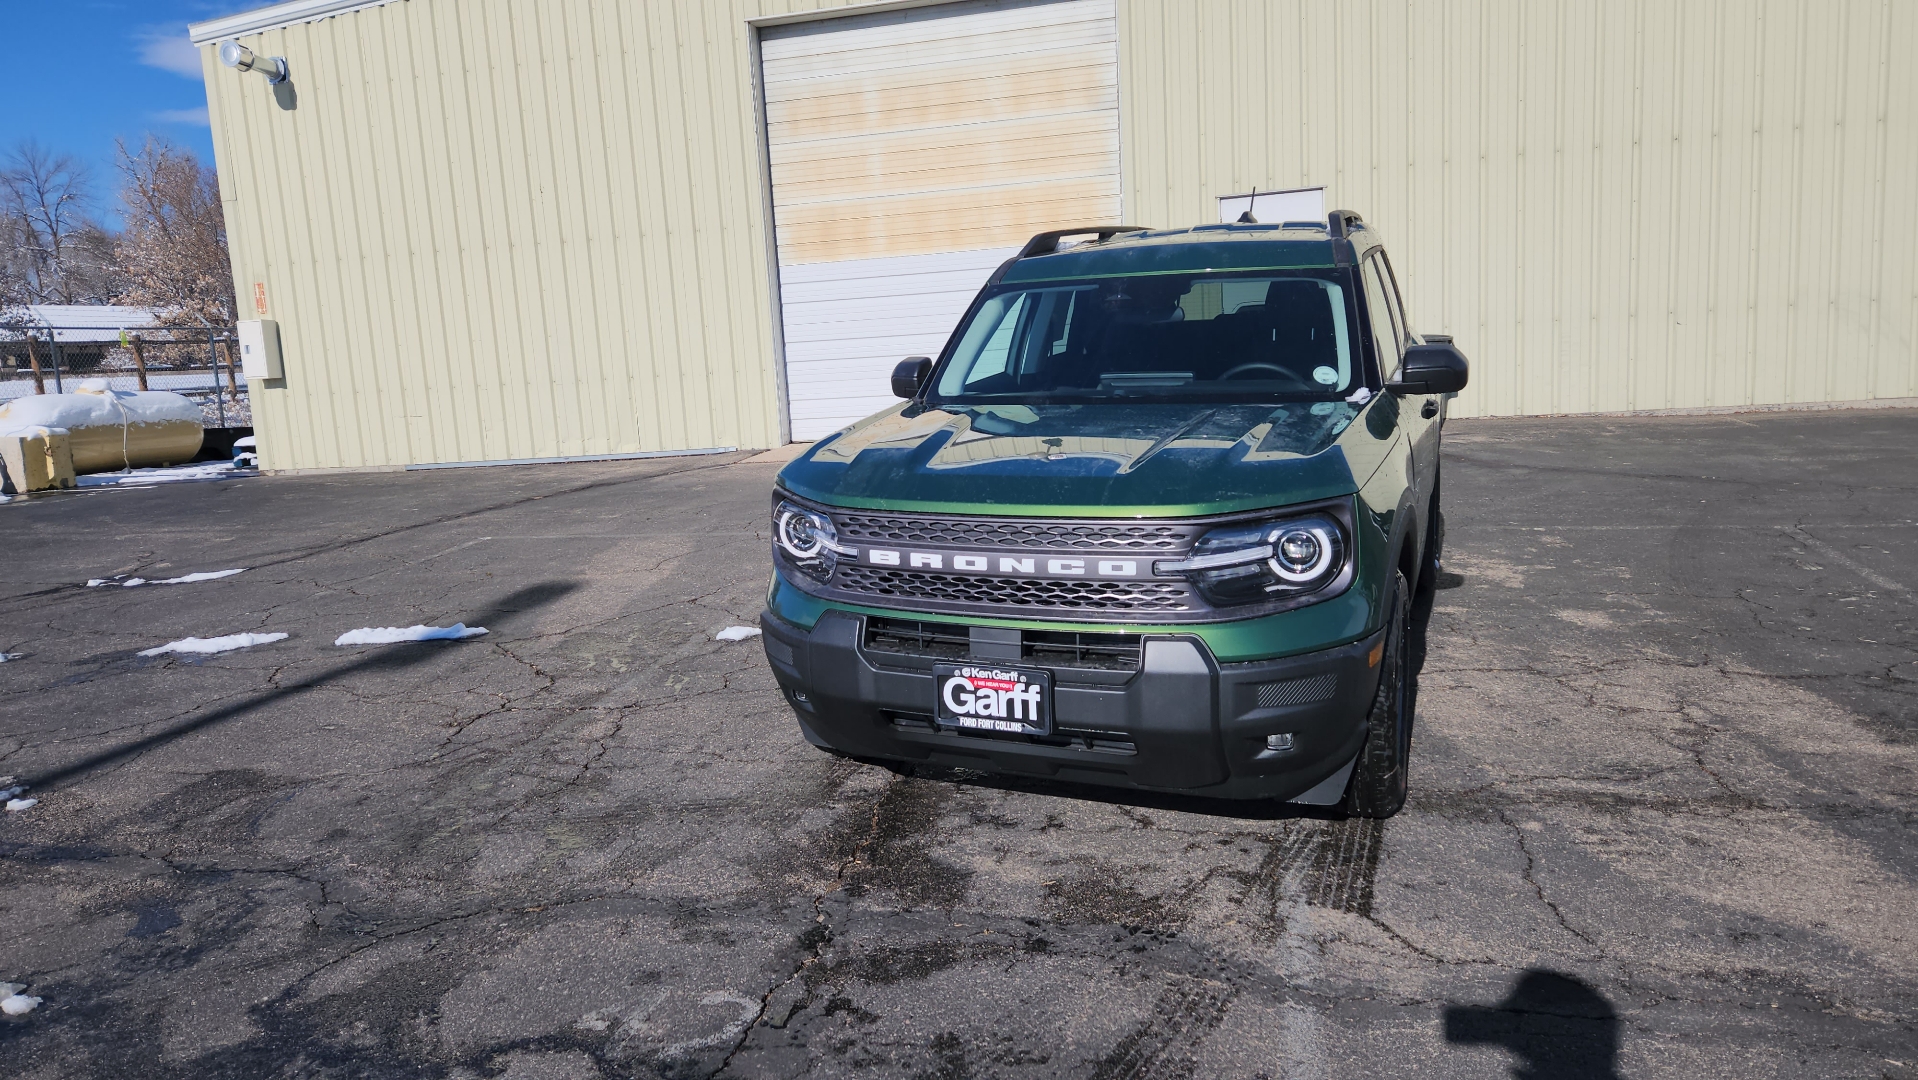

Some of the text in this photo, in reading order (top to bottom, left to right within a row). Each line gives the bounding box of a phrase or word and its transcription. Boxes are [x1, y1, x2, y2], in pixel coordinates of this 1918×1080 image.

[869, 549, 1137, 576] BRONCO
[971, 667, 1018, 682] Ken Garff
[943, 677, 1041, 721] Garff
[960, 717, 1022, 732] FORD FORT COLLINS
